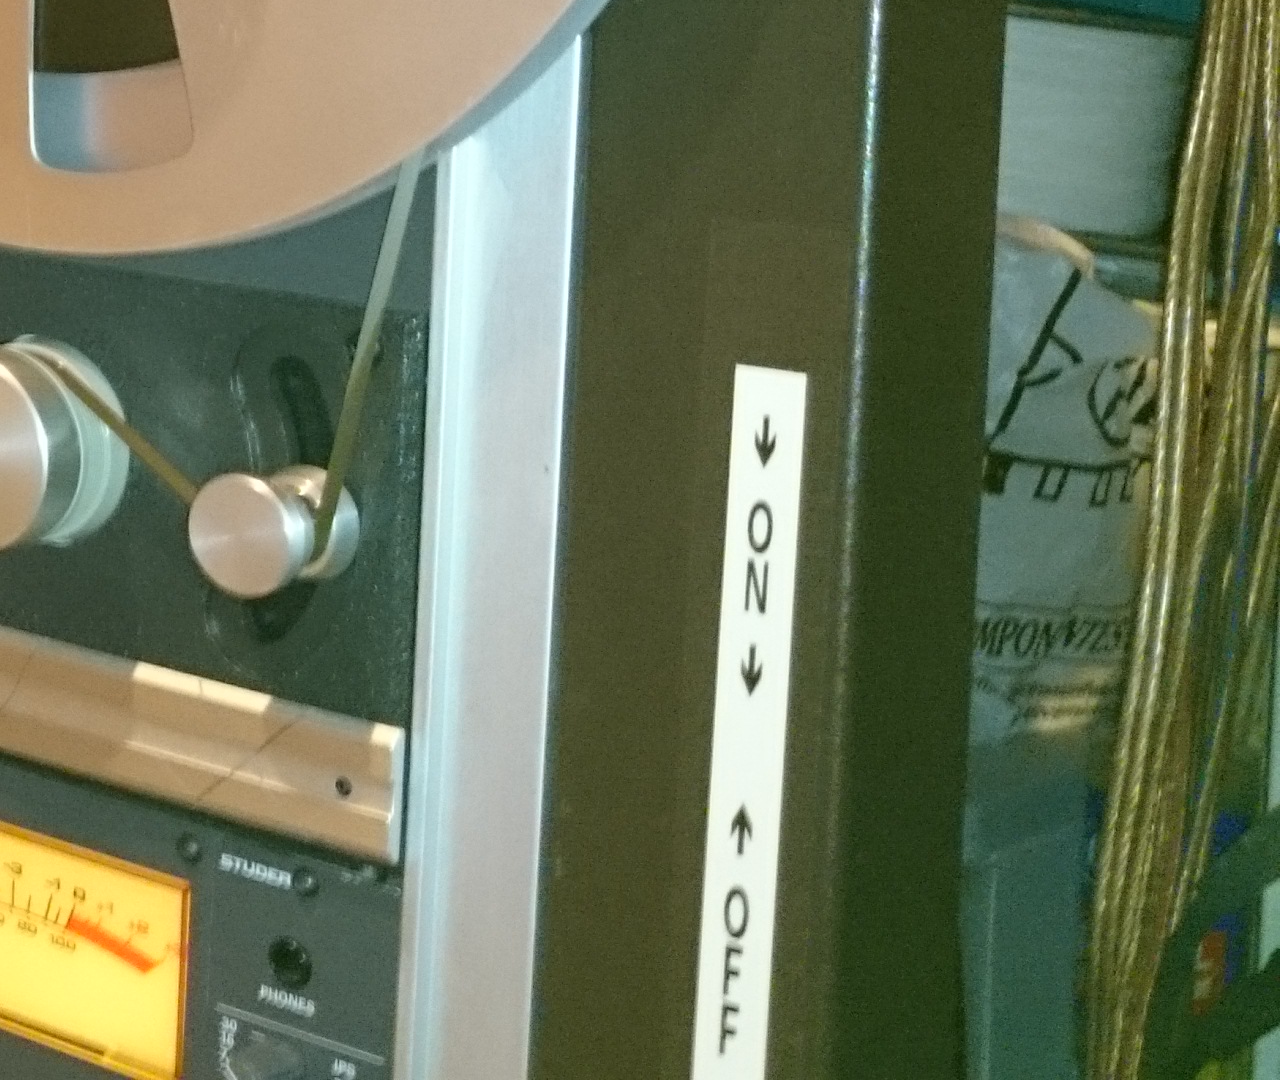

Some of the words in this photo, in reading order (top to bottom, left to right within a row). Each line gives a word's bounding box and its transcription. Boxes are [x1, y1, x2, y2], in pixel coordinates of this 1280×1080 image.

[745, 499, 774, 615] ON
[219, 852, 292, 890] STUDER
[73, 887, 87, 902] 0
[17, 919, 38, 935] 80
[50, 933, 77, 952] 100
[718, 884, 750, 1056] OFF
[258, 984, 316, 1018] PHONES
